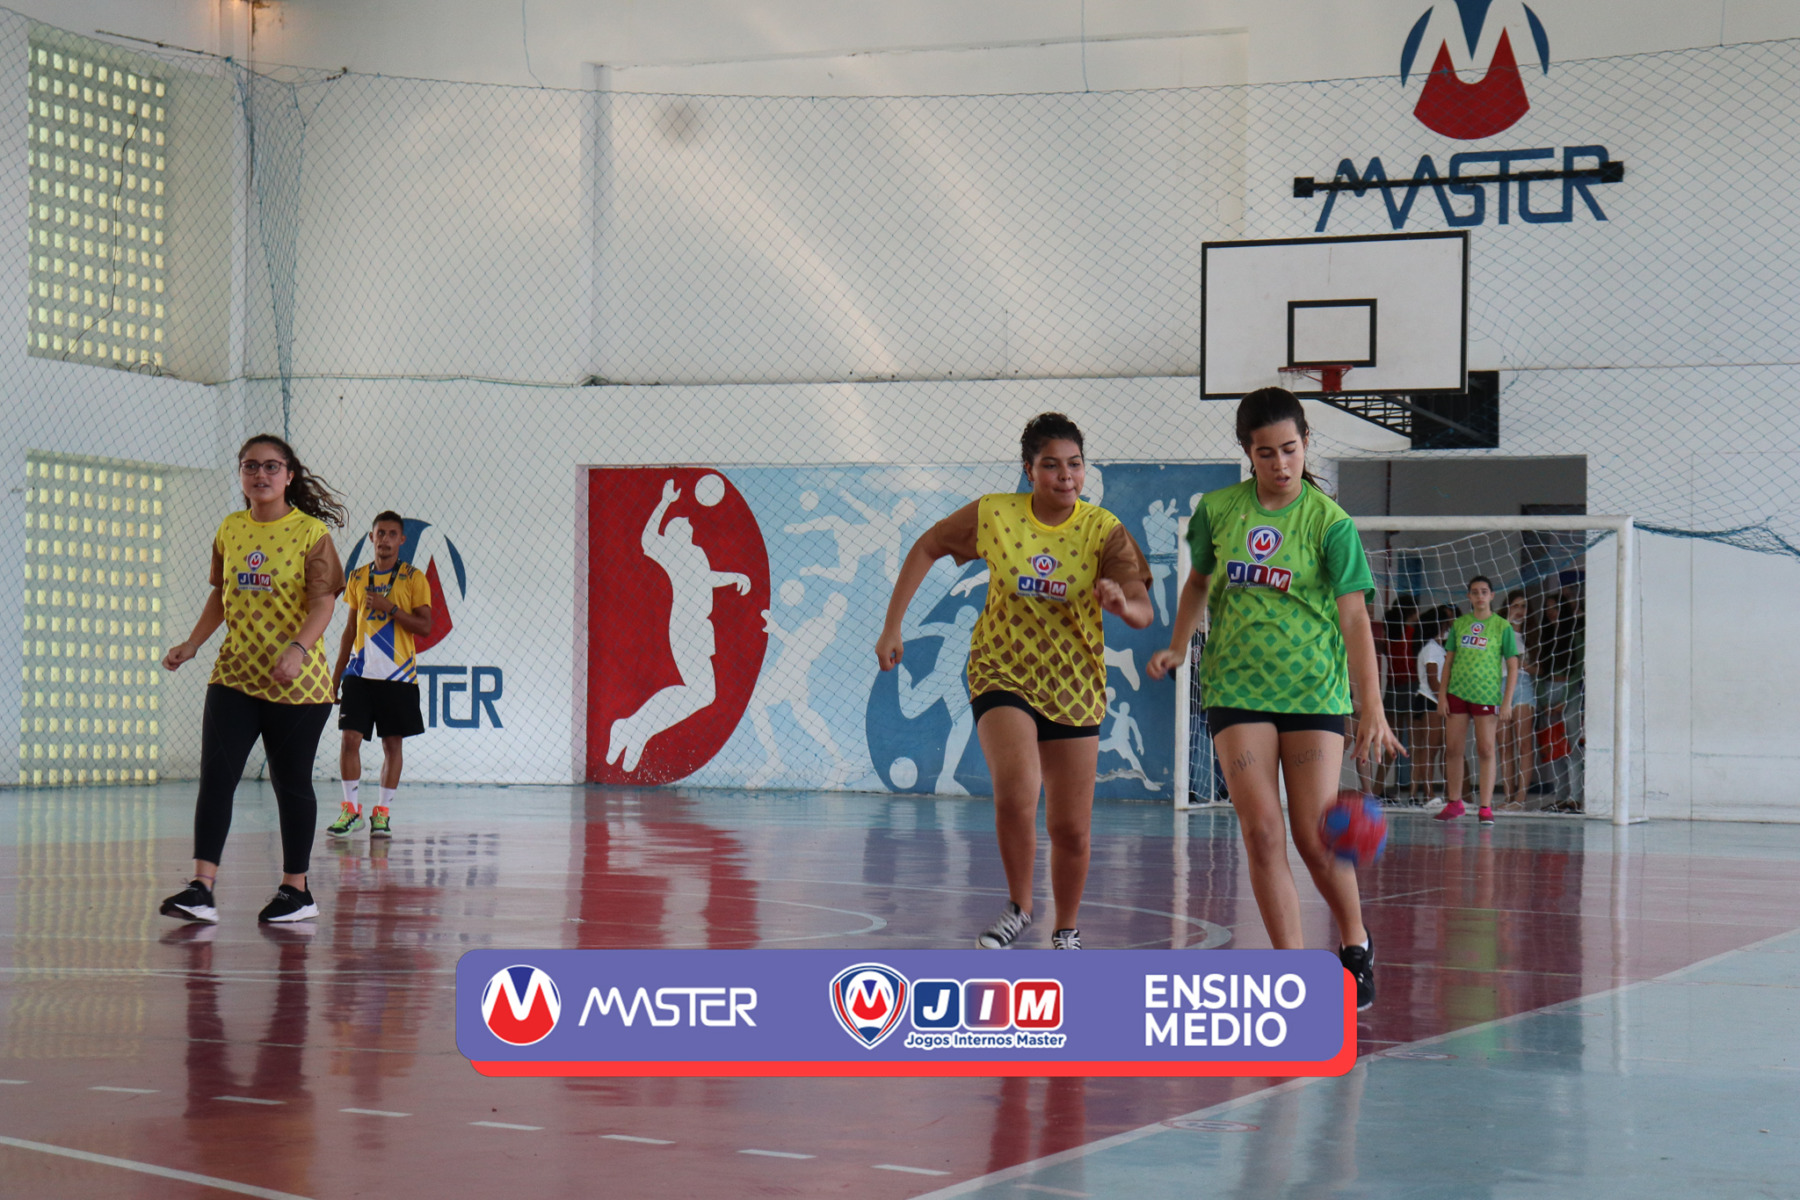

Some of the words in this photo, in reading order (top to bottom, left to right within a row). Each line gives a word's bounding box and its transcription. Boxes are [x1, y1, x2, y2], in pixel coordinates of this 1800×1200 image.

[1314, 145, 1609, 233] MASTER
[239, 574, 271, 585] JIM
[1020, 578, 1066, 596] JIM
[1230, 565, 1291, 589] JIM
